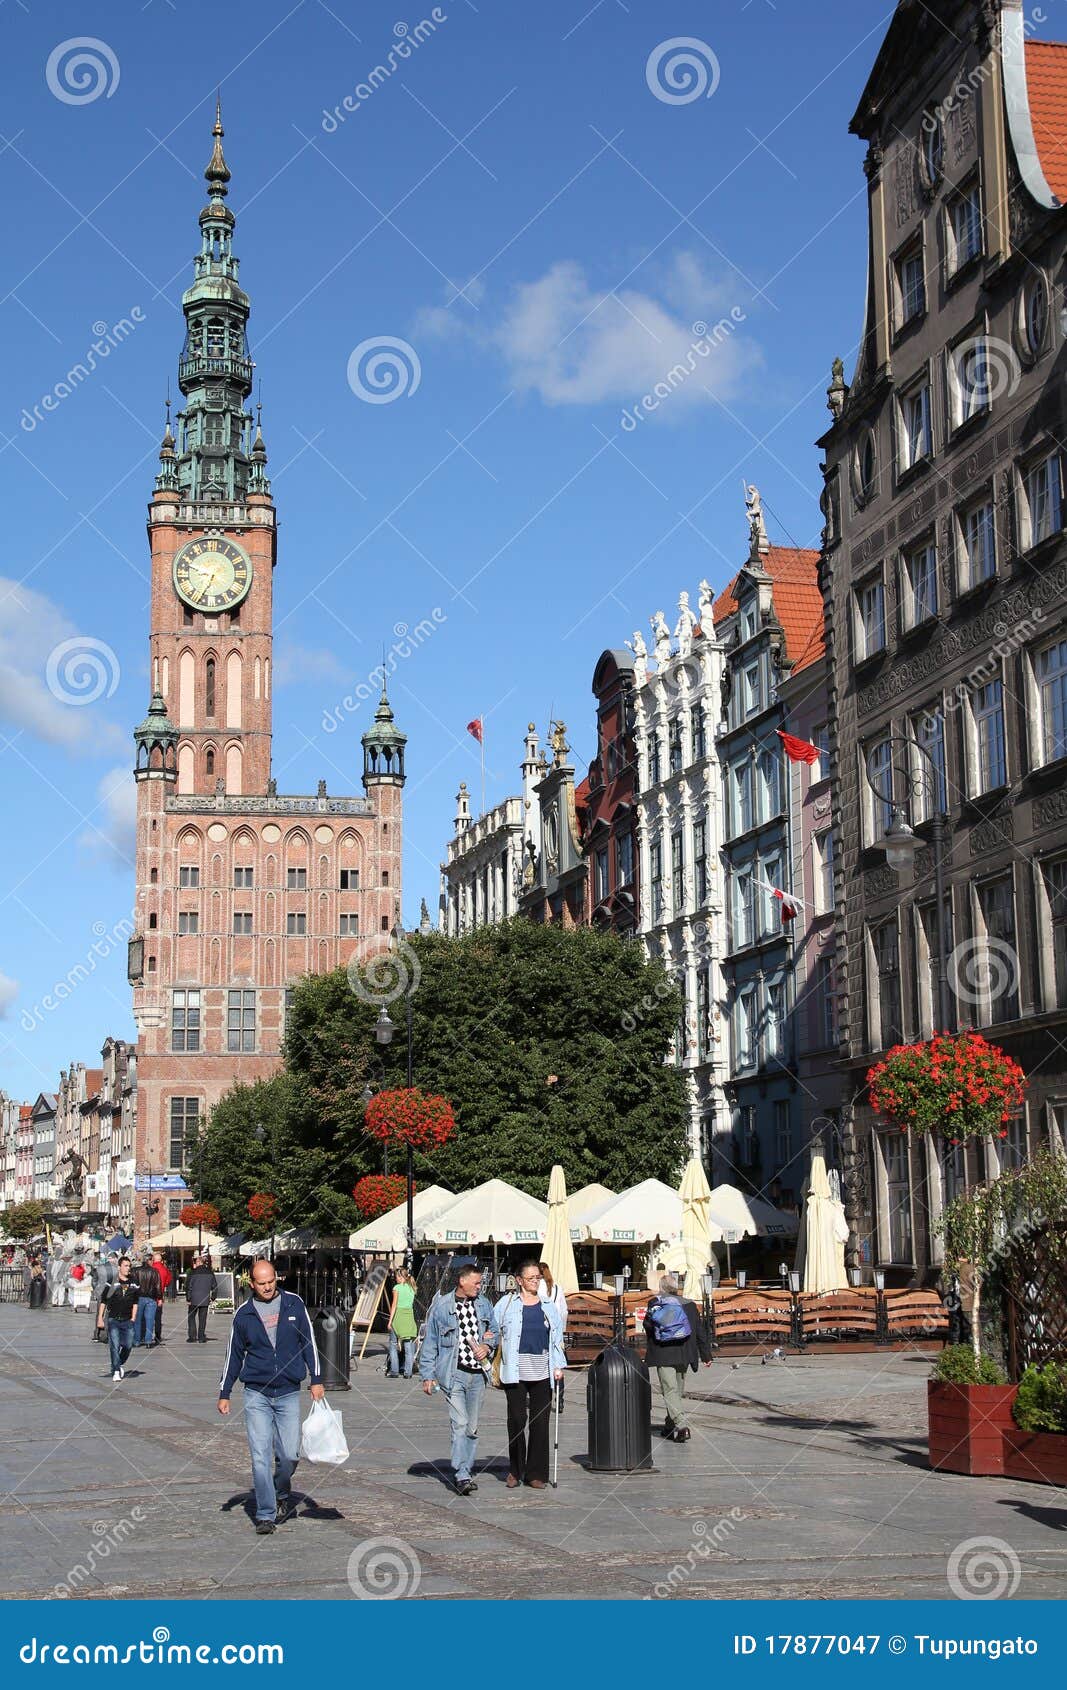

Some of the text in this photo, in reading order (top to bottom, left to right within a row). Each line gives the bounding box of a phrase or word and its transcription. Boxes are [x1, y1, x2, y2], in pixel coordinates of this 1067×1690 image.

[447, 1232, 466, 1240] LECH
[517, 1231, 537, 1240] LECH
[615, 1231, 633, 1239] LECH
